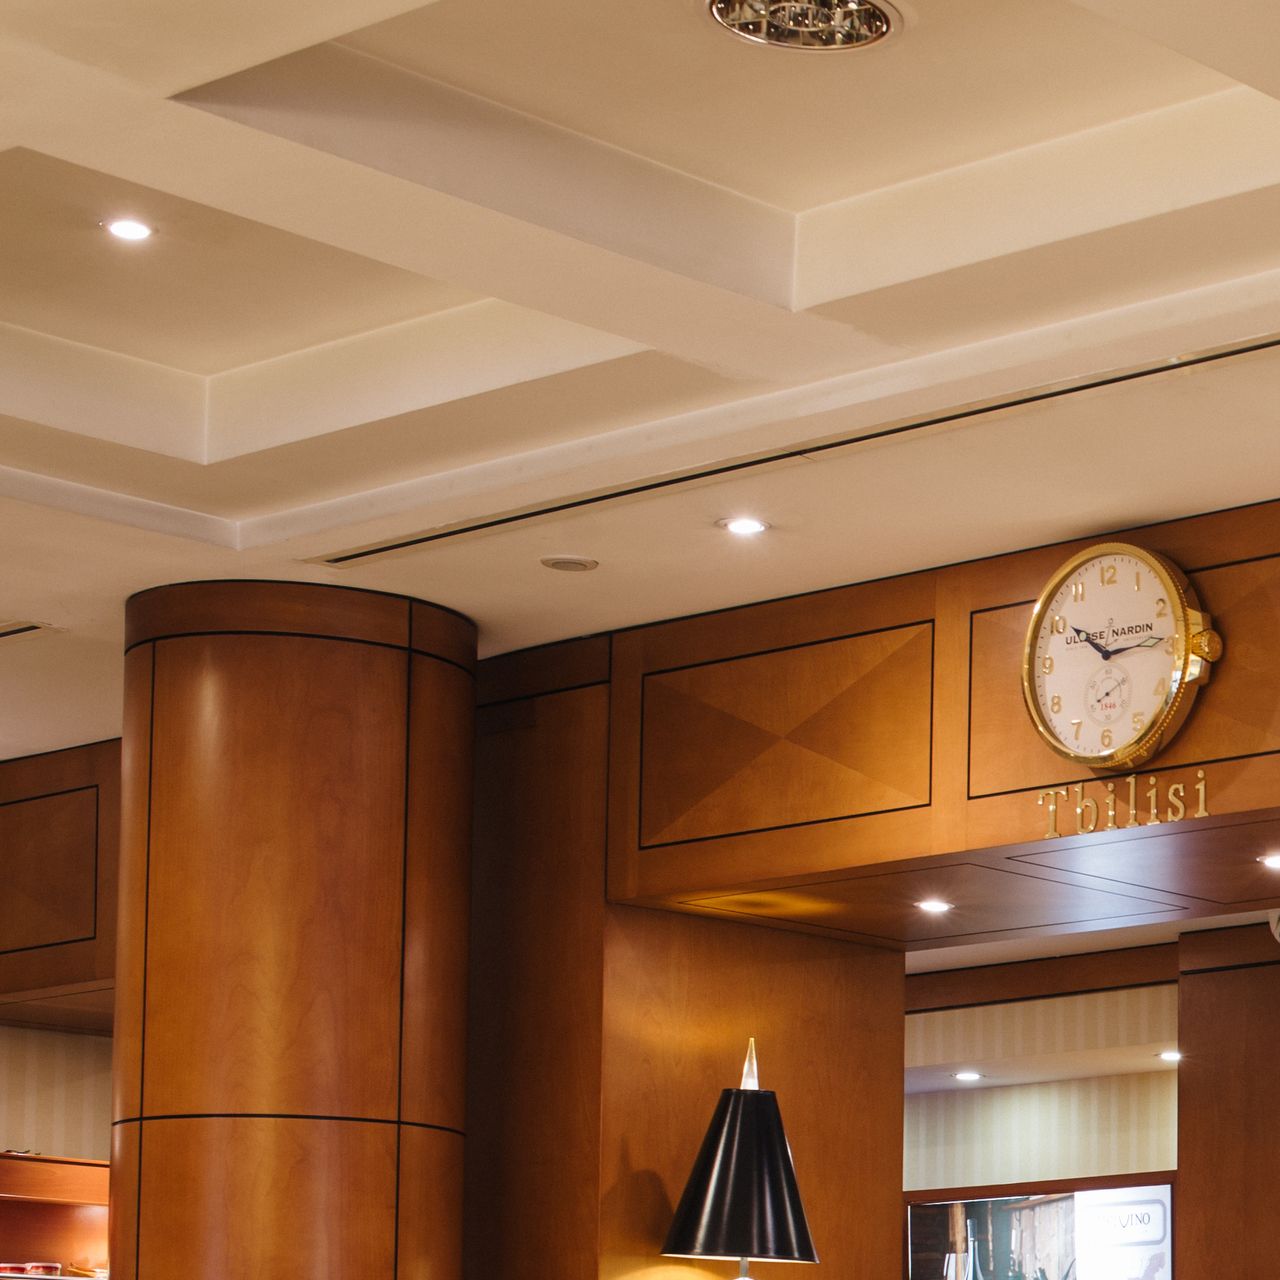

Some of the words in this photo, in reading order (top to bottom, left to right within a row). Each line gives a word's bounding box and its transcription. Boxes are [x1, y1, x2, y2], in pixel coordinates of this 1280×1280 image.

[1100, 565, 1117, 586] 12
[1072, 582, 1084, 601] 11
[1156, 598, 1167, 618] 2
[1051, 616, 1066, 634] 10
[1112, 623, 1153, 637] NARDIN
[1042, 655, 1053, 674] 9
[1051, 694, 1061, 713] 8
[1072, 720, 1082, 740] 7
[1101, 729, 1112, 747] 6
[1037, 769, 1209, 839] Tbilisi
